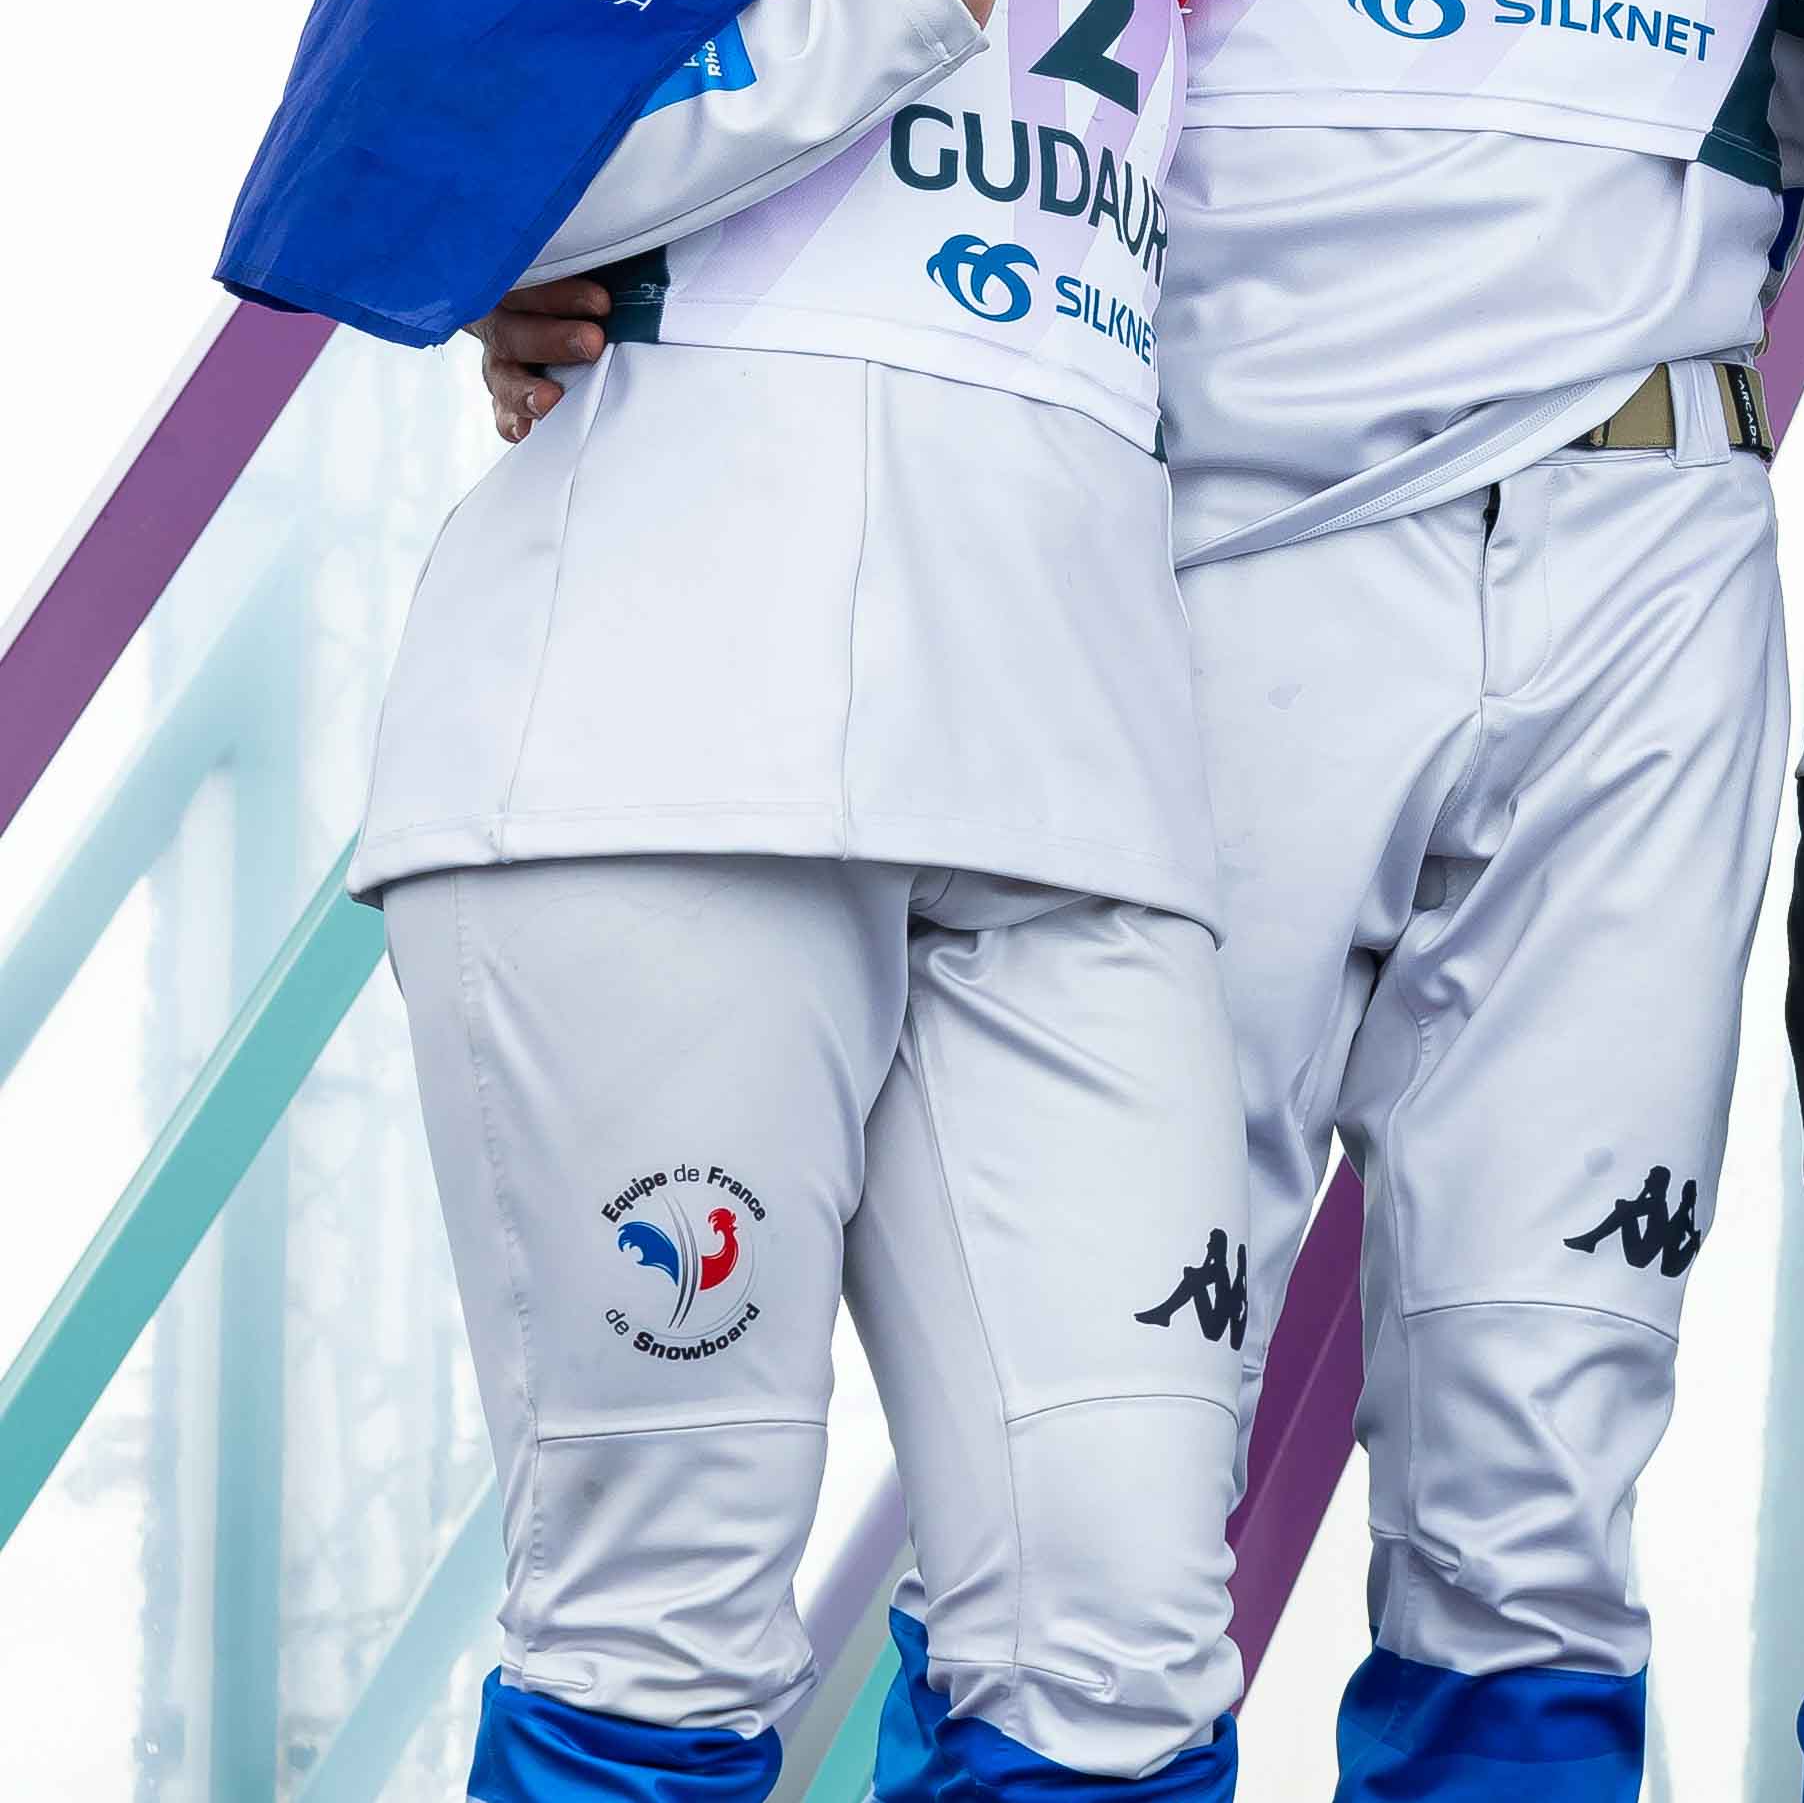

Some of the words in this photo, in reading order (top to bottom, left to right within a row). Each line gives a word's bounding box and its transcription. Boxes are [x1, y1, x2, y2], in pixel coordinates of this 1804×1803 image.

[890, 103, 1168, 287] GUDAUR
[600, 1172, 668, 1224] Equipe
[673, 1163, 700, 1183] de
[706, 1166, 767, 1222] France
[605, 1308, 630, 1336] de
[632, 1302, 761, 1361] Snowboard
